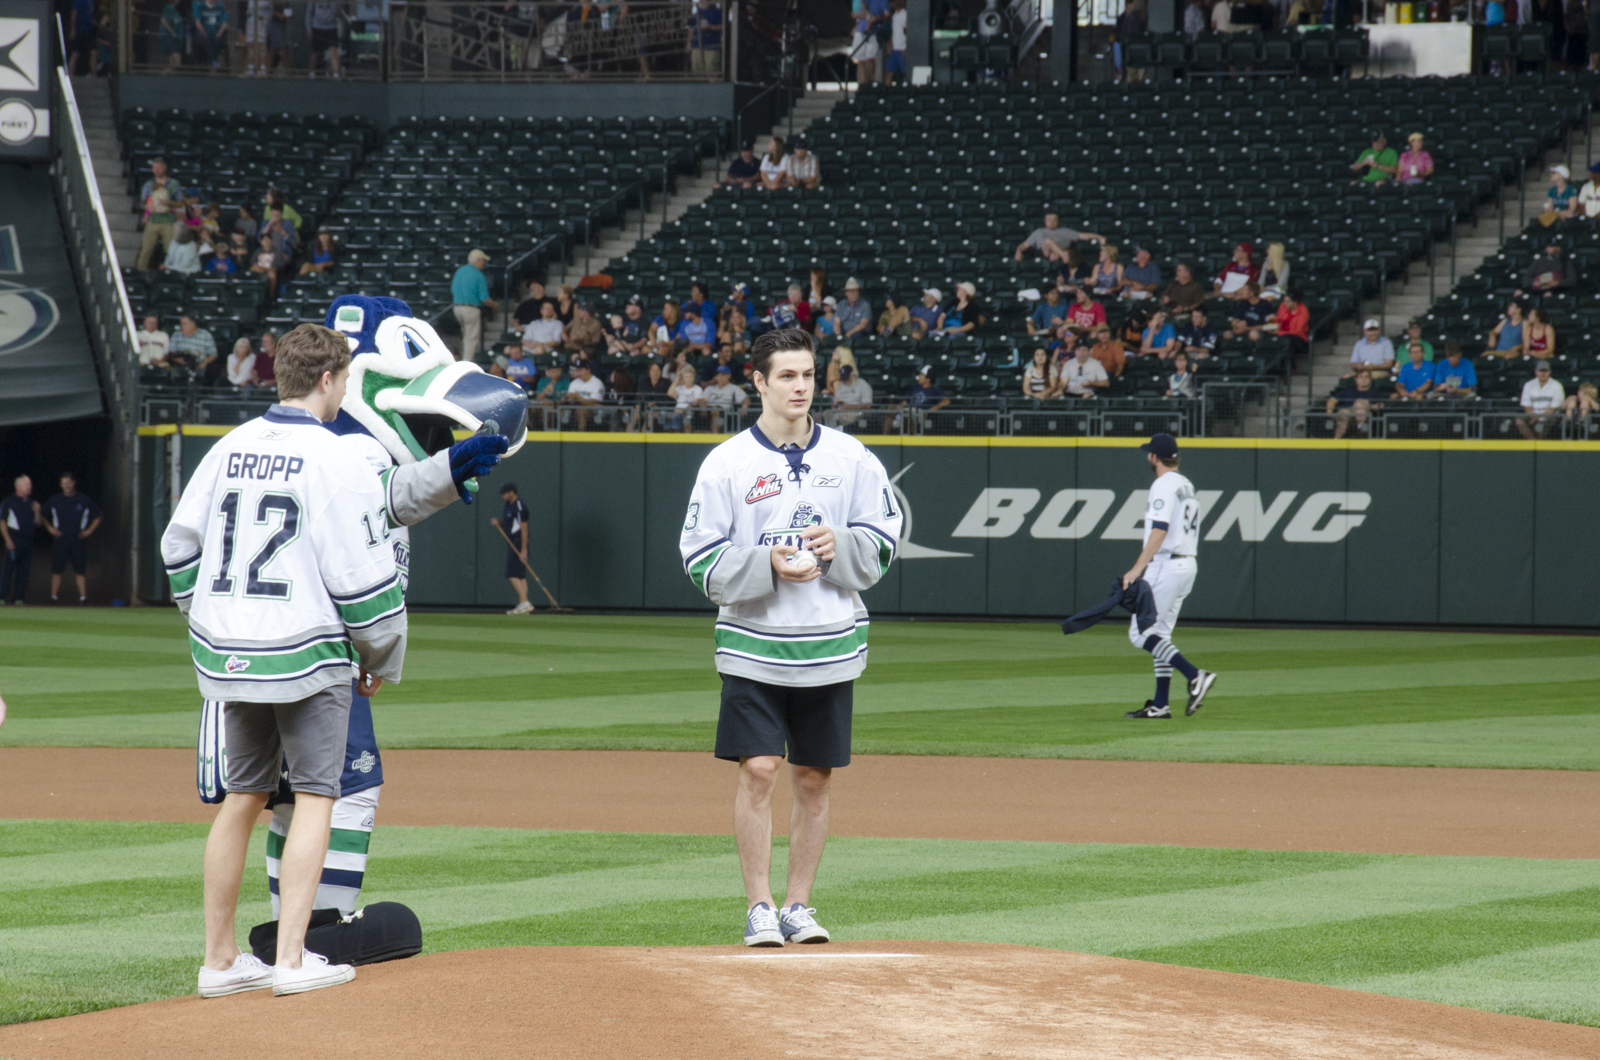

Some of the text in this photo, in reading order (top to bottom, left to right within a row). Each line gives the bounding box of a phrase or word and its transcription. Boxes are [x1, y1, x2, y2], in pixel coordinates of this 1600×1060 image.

[1, 120, 28, 128] FIRST
[226, 452, 304, 482] GROPP
[750, 480, 782, 498] WHL
[1183, 503, 1200, 538] 54
[209, 487, 303, 601] 12
